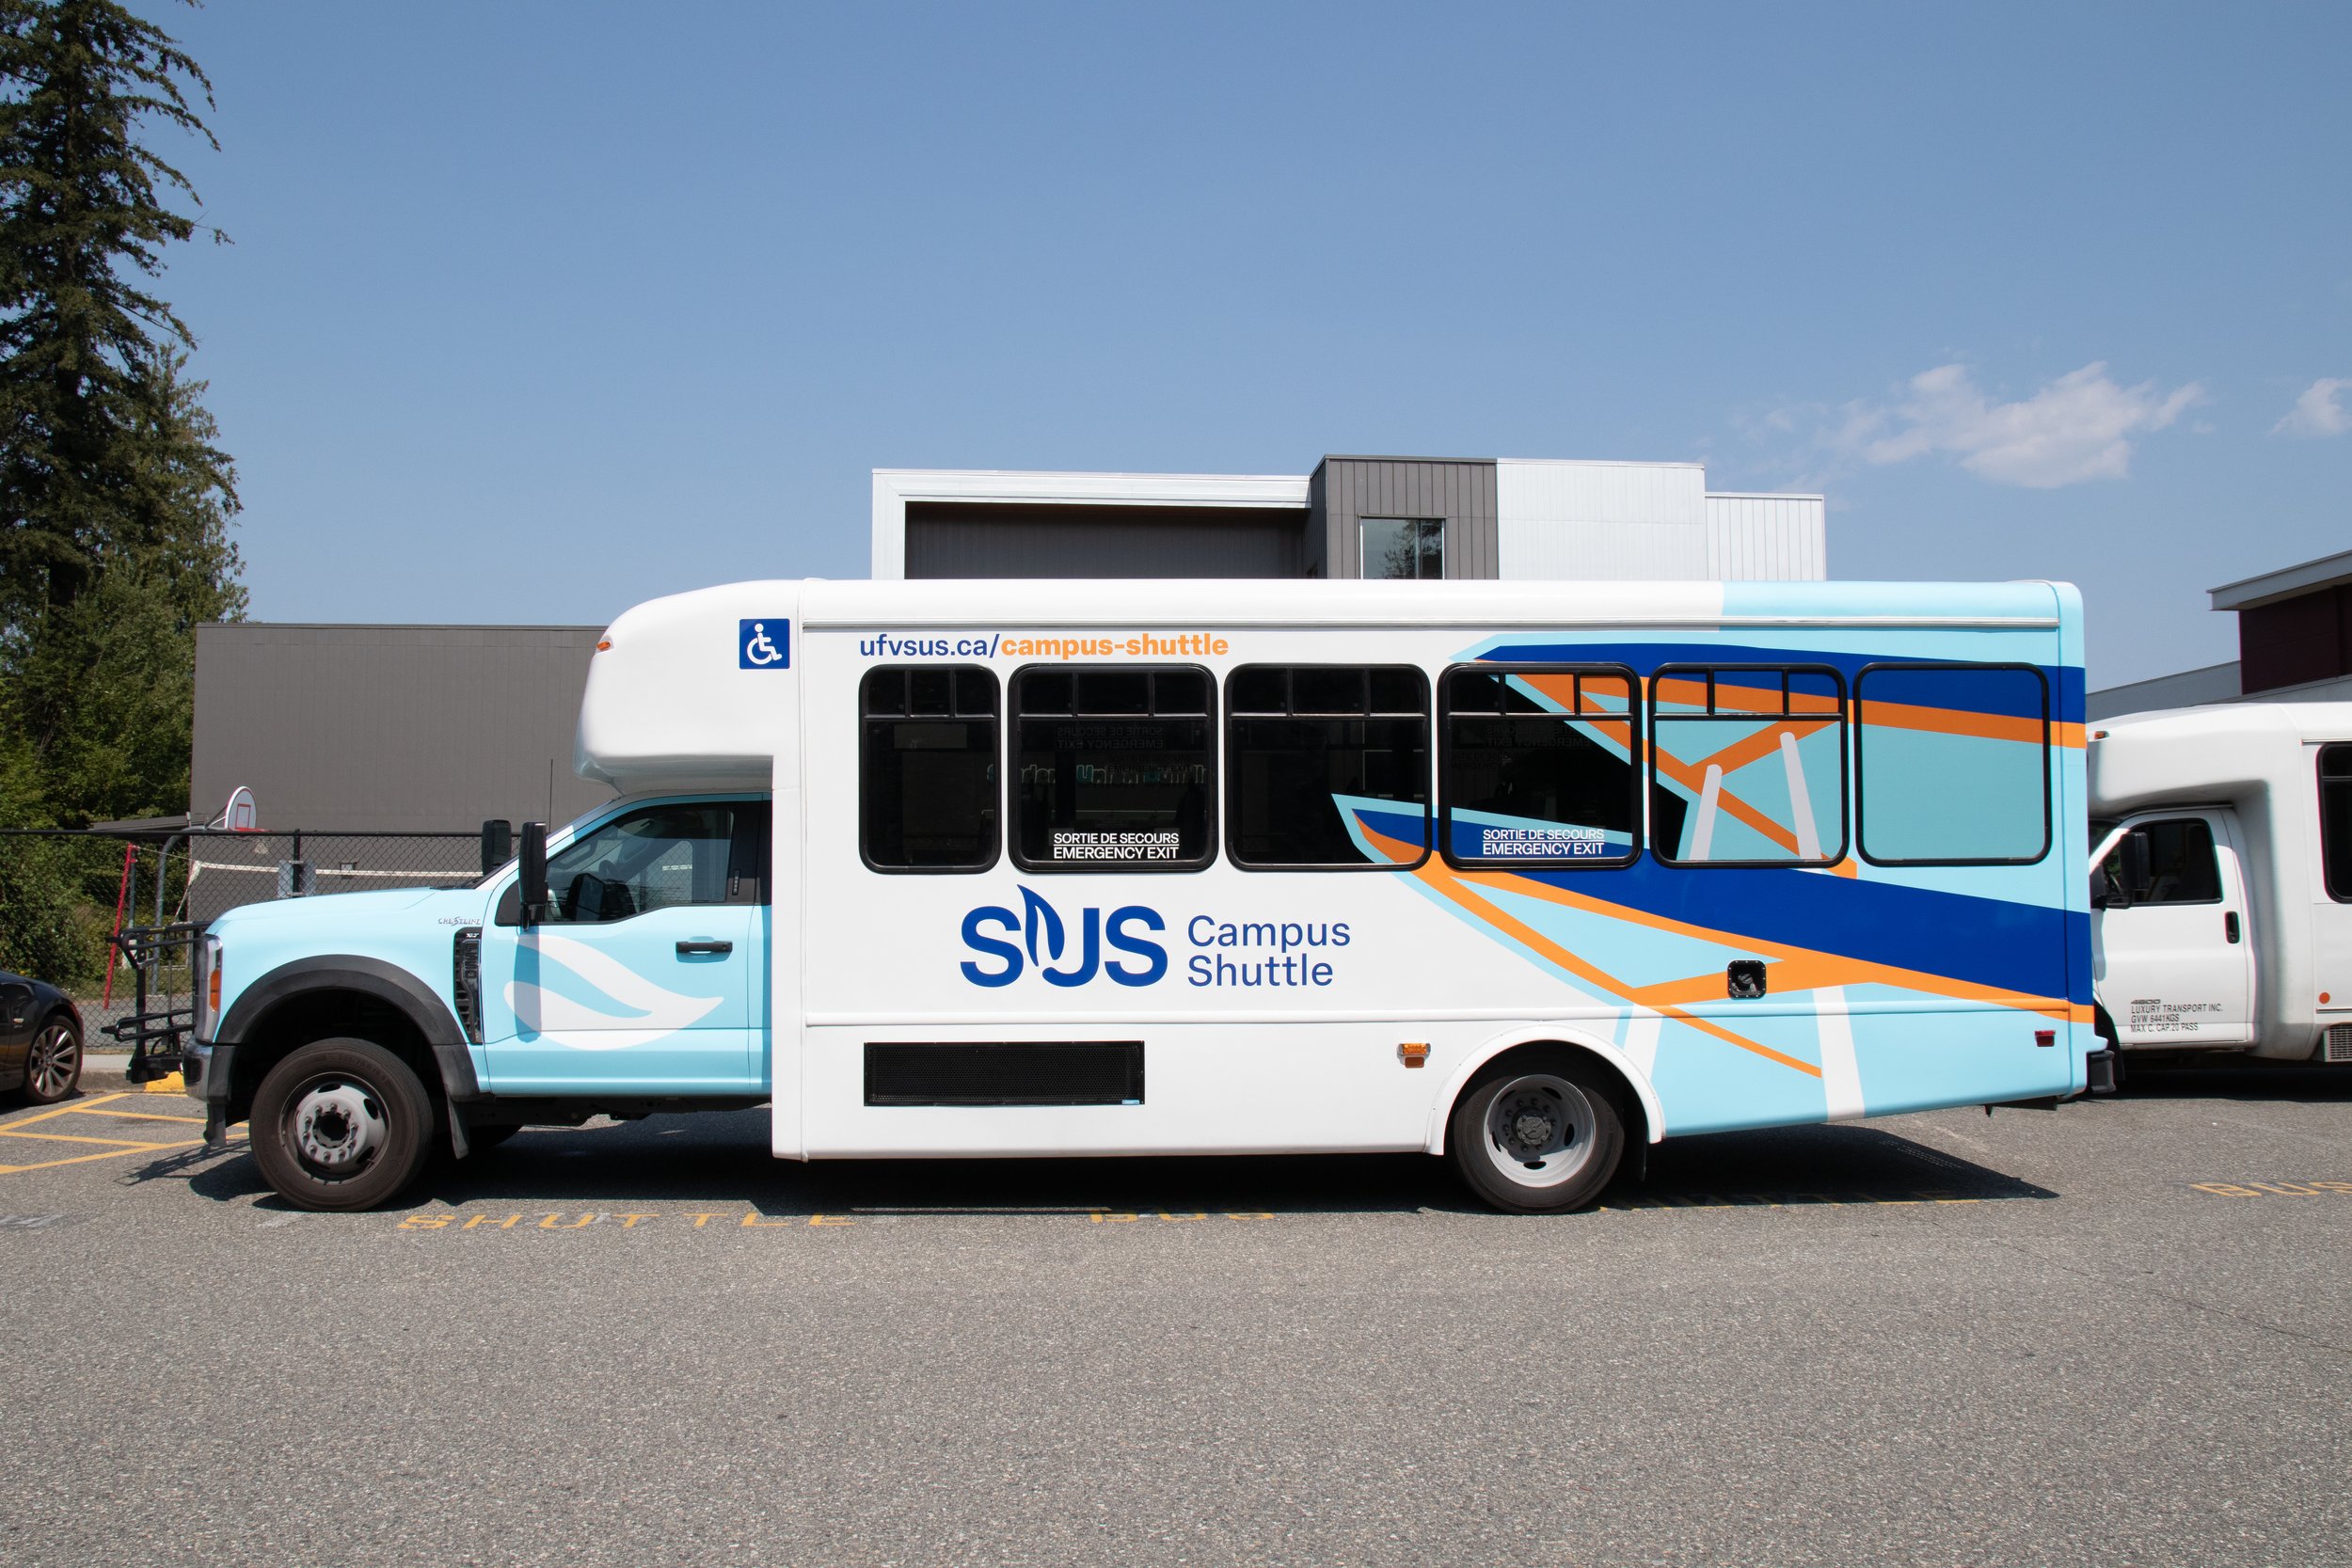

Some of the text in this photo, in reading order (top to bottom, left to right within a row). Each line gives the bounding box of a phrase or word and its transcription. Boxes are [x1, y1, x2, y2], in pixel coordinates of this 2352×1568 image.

[860, 632, 1230, 660] ufvsus.ca/campus-shuttle
[1054, 832, 1180, 844] SORTIE DE SECOURS
[1483, 829, 1604, 840] SORTIE DE SECOURS
[1053, 847, 1180, 860] EMERGENCY EXIT
[1483, 842, 1605, 855] EMERGENCY EXIT
[960, 884, 1168, 988] SUS
[1187, 915, 1351, 954] Campus
[1187, 953, 1334, 988] Shuttle
[2131, 1003, 2224, 1014] LUXURY TRANSPORT INC.
[2131, 1014, 2148, 1023] GVW
[2130, 1023, 2146, 1033] MAX
[2181, 1022, 2199, 1031] PASS
[397, 1212, 858, 1229] SHUTTLE
